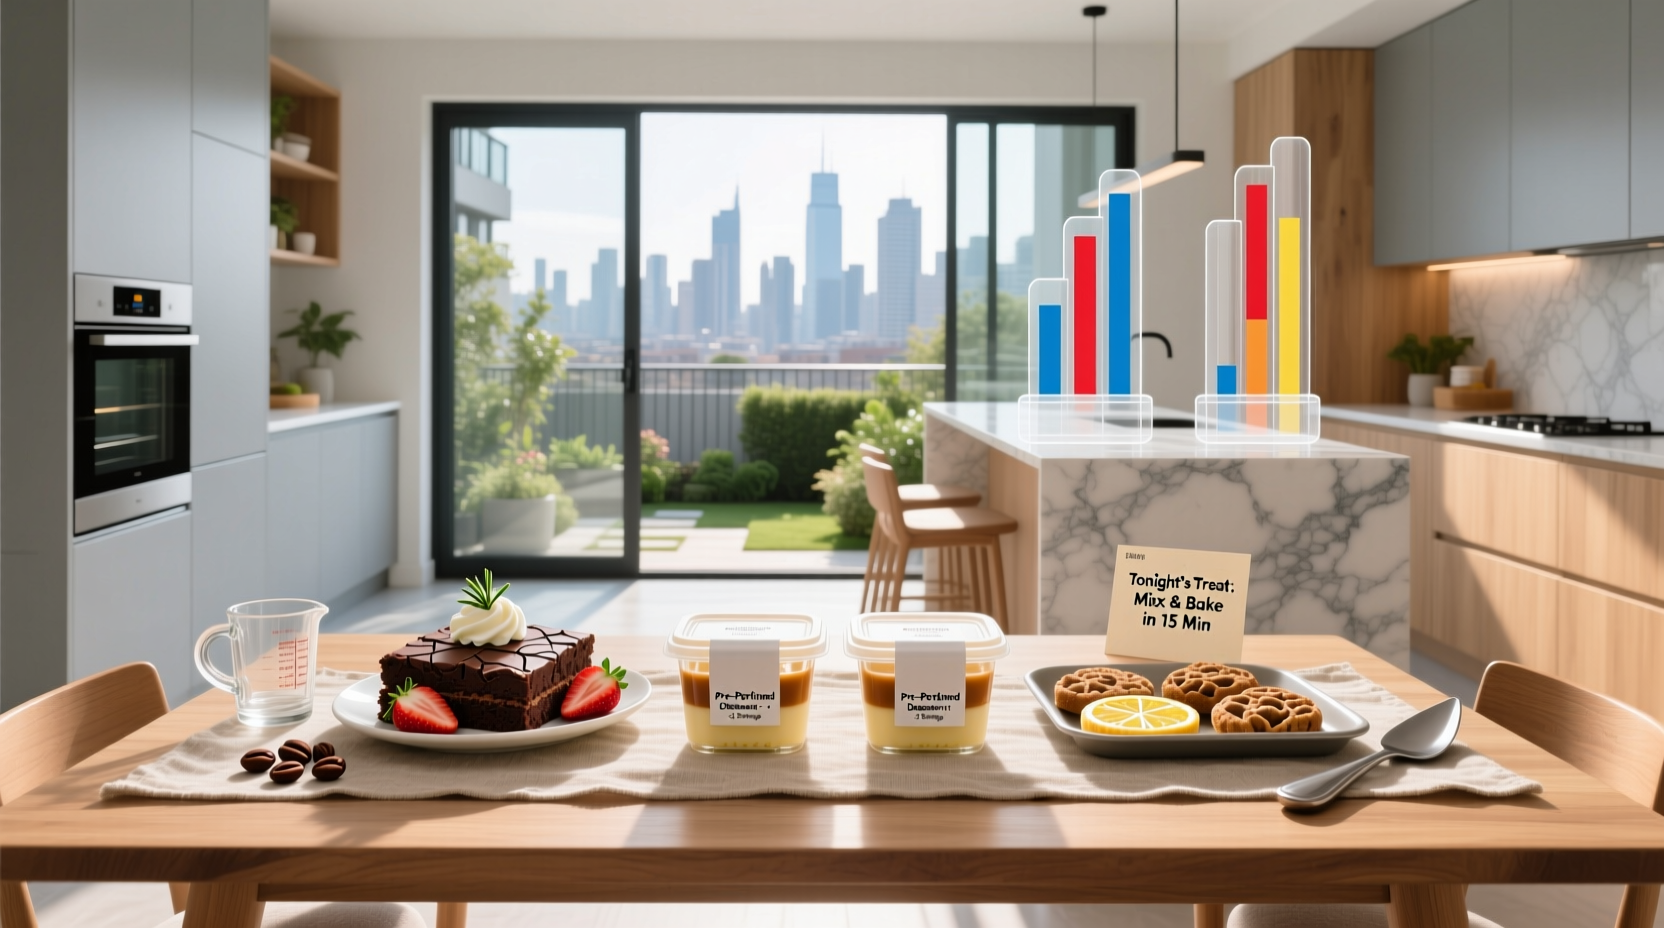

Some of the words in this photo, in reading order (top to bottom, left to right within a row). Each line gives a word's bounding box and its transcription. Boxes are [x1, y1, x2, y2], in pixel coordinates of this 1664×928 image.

[1129, 572, 1191, 591] Tonight's
[1193, 577, 1235, 593] Treat:
[1169, 595, 1181, 609] &
[1186, 596, 1224, 612] Bake
[1142, 611, 1156, 626] in
[1162, 613, 1178, 628] 15
[1182, 614, 1211, 632] Min
